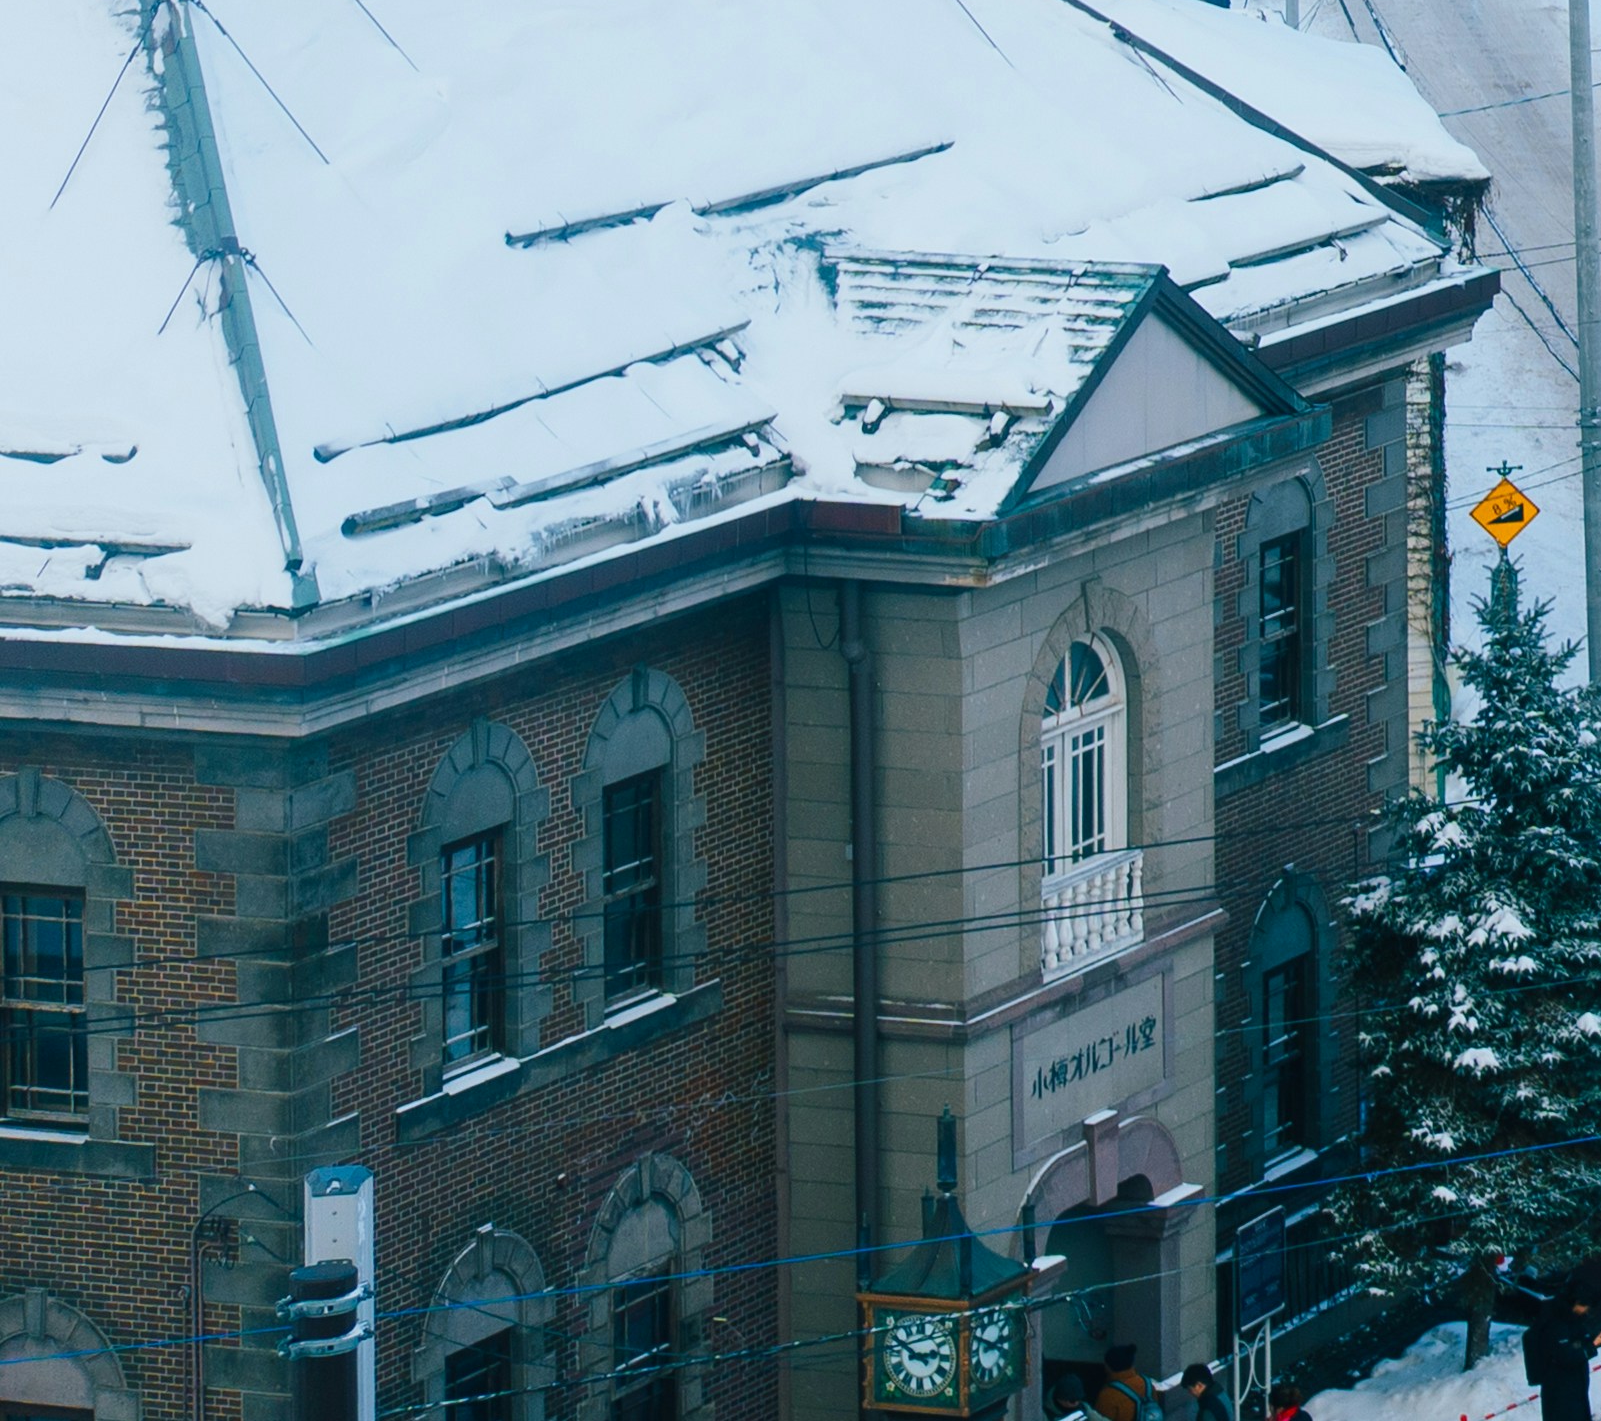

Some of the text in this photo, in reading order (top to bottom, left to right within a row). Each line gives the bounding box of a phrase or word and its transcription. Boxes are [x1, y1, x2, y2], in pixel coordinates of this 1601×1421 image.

[1031, 1015, 1156, 1100] 小樽オルゴール堂
